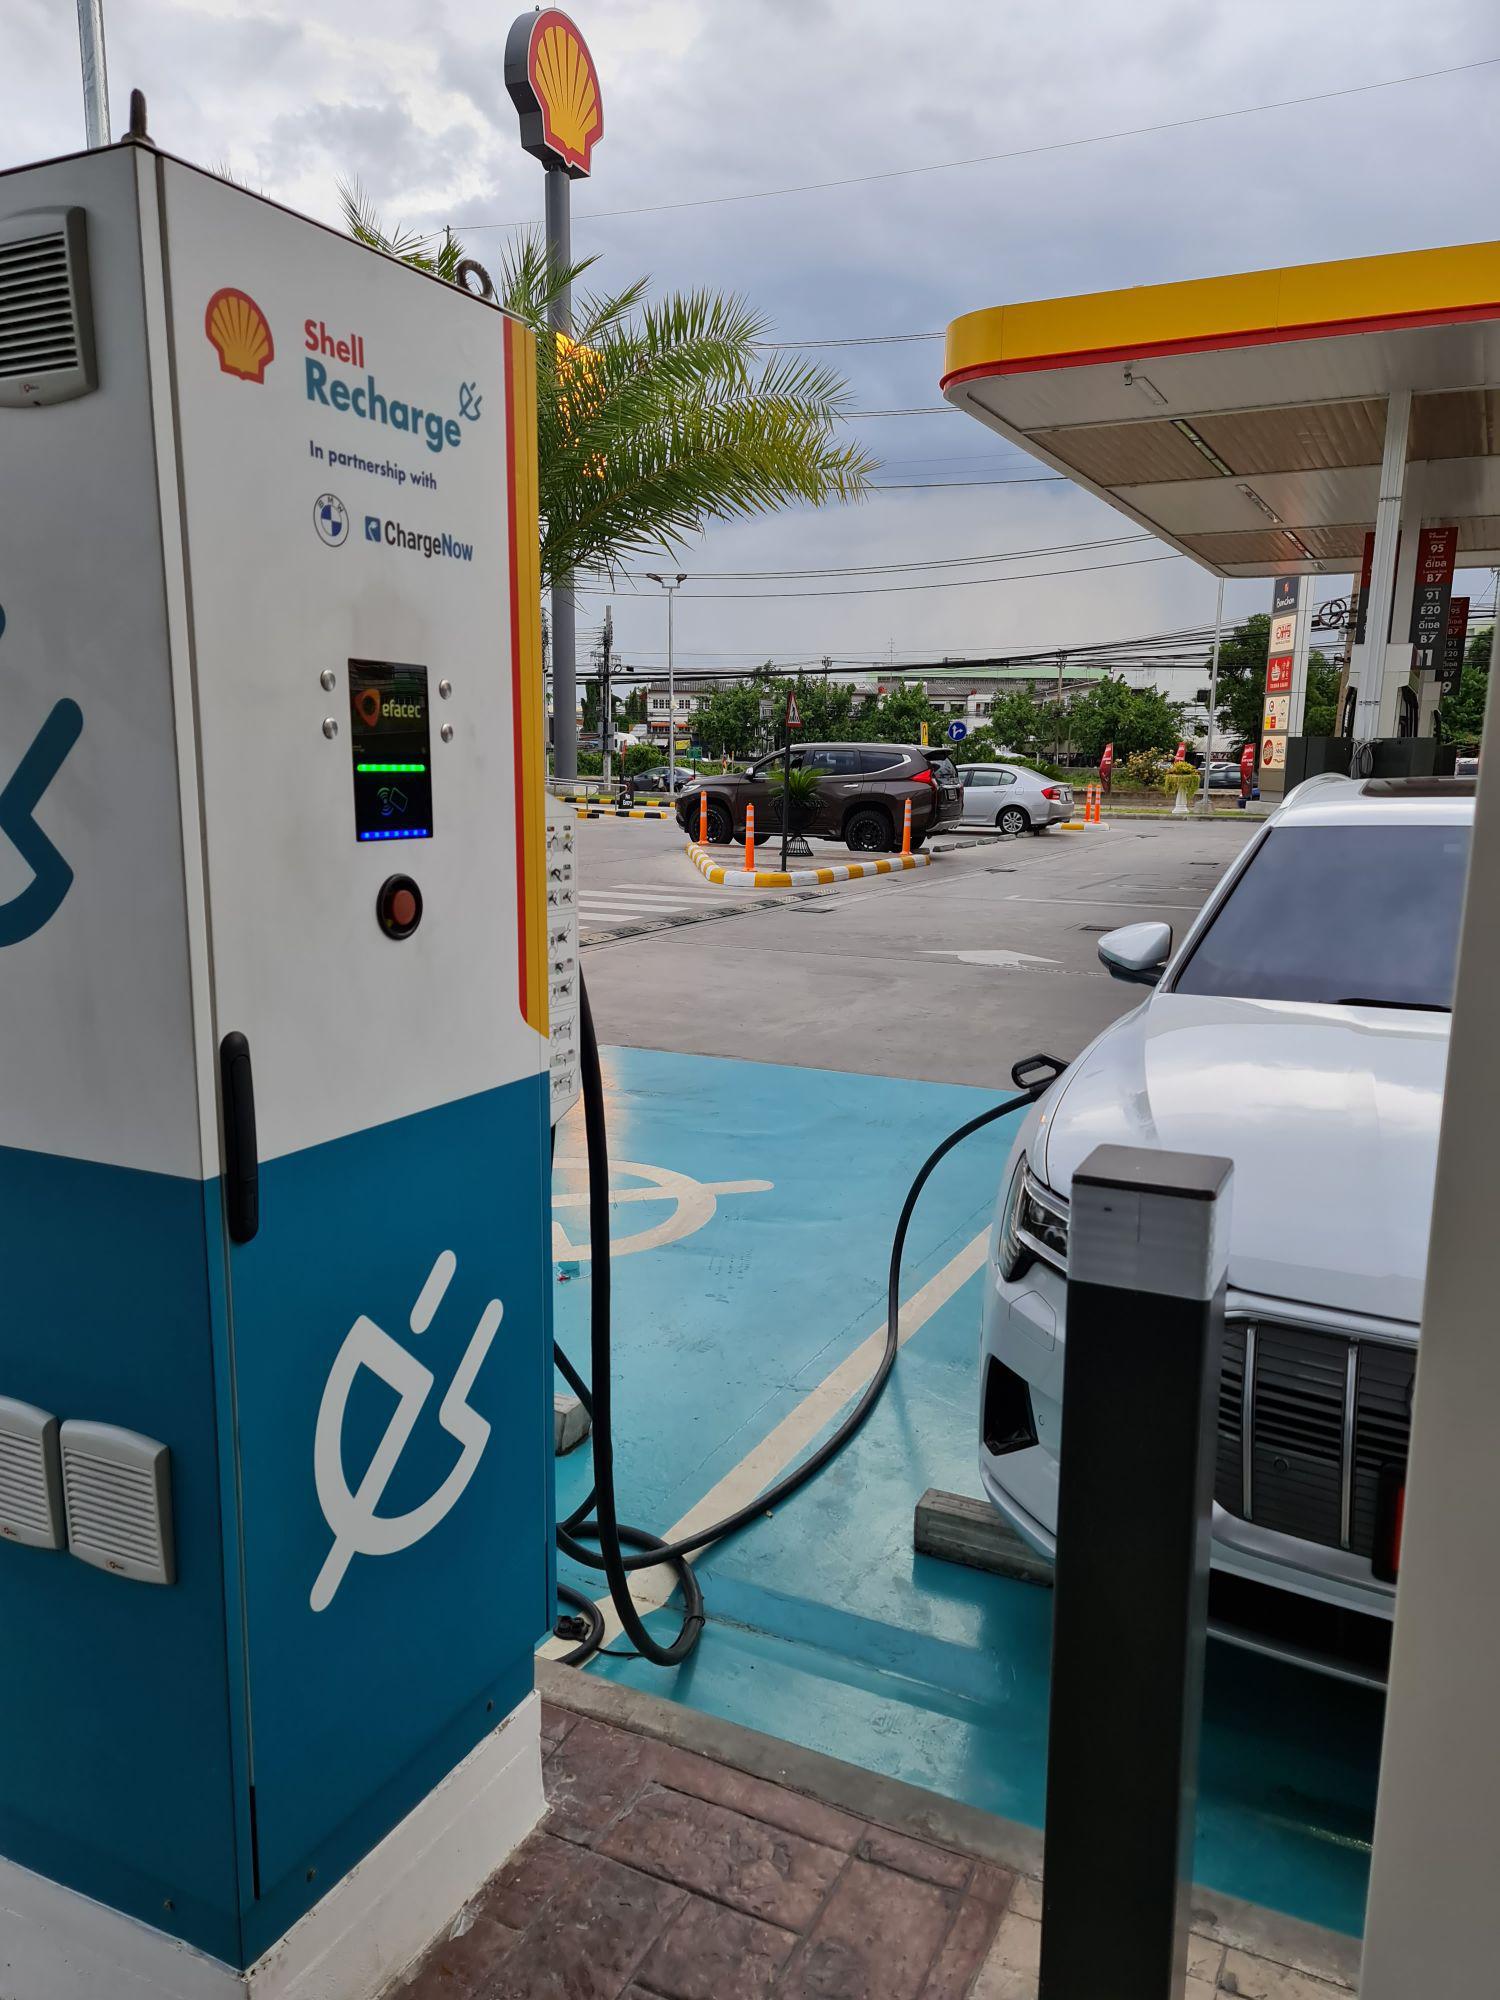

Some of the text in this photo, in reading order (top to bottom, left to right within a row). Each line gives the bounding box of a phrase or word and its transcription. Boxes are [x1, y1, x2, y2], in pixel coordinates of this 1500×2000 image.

[304, 319, 364, 368] Shell
[305, 357, 461, 452] Recharge
[310, 440, 437, 490] In partnership with
[384, 520, 473, 561] ChargeNow
[1430, 544, 1445, 553] 95
[1426, 591, 1440, 600] 91
[1420, 606, 1441, 615] E20
[1420, 634, 1436, 644] B7
[382, 699, 421, 719] efacec
